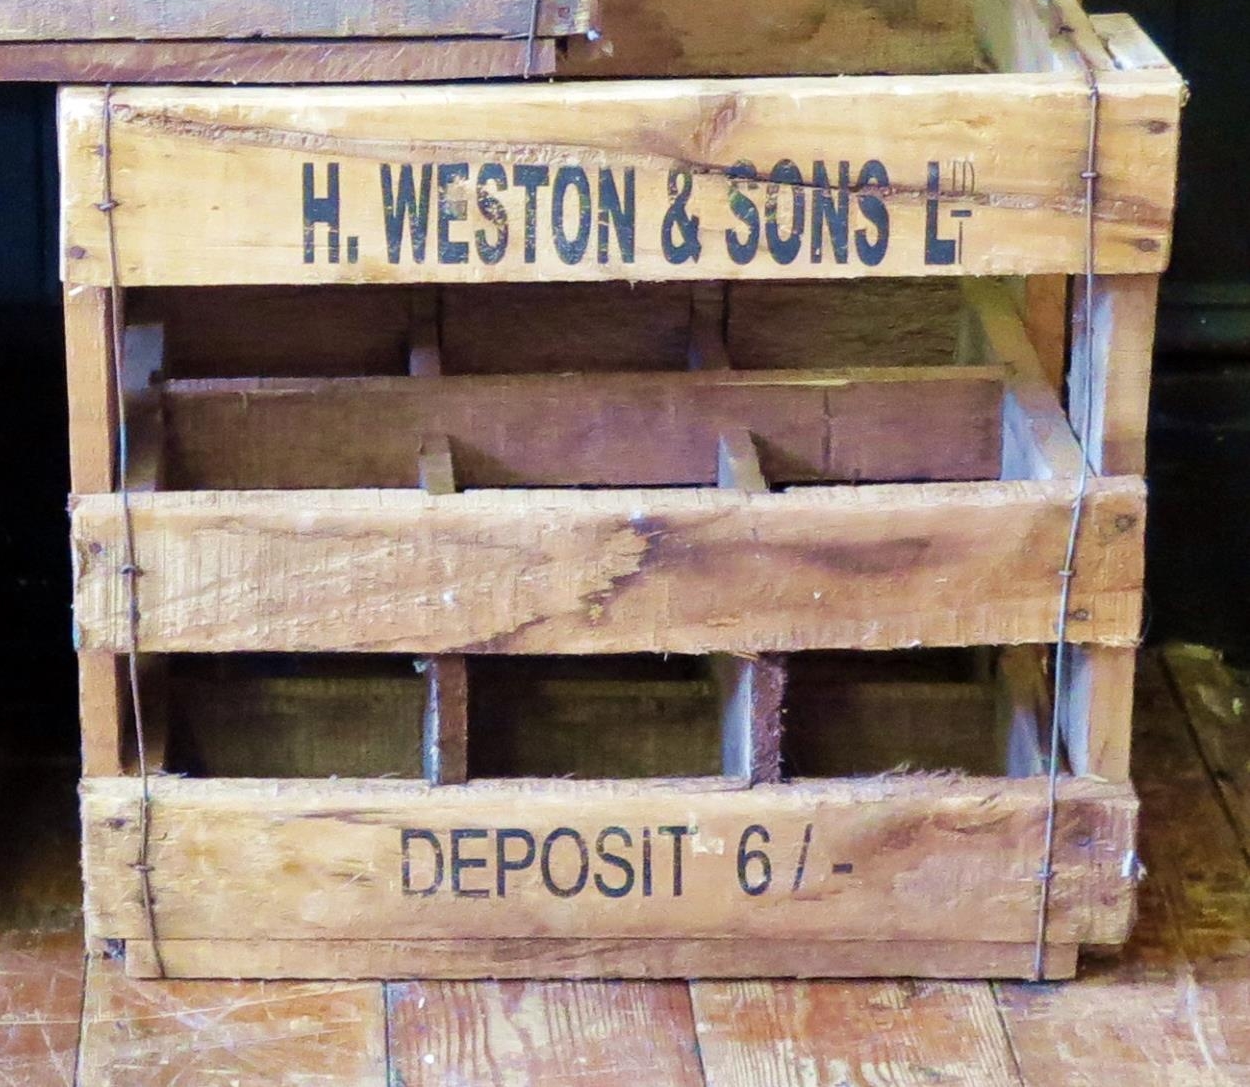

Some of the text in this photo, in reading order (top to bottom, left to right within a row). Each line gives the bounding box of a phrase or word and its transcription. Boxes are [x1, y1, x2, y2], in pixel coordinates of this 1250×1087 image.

[301, 161, 358, 265] H.
[379, 161, 636, 265] WESTON
[660, 161, 703, 265] &
[724, 158, 891, 266] SONS
[400, 825, 699, 899] DEPOSIT
